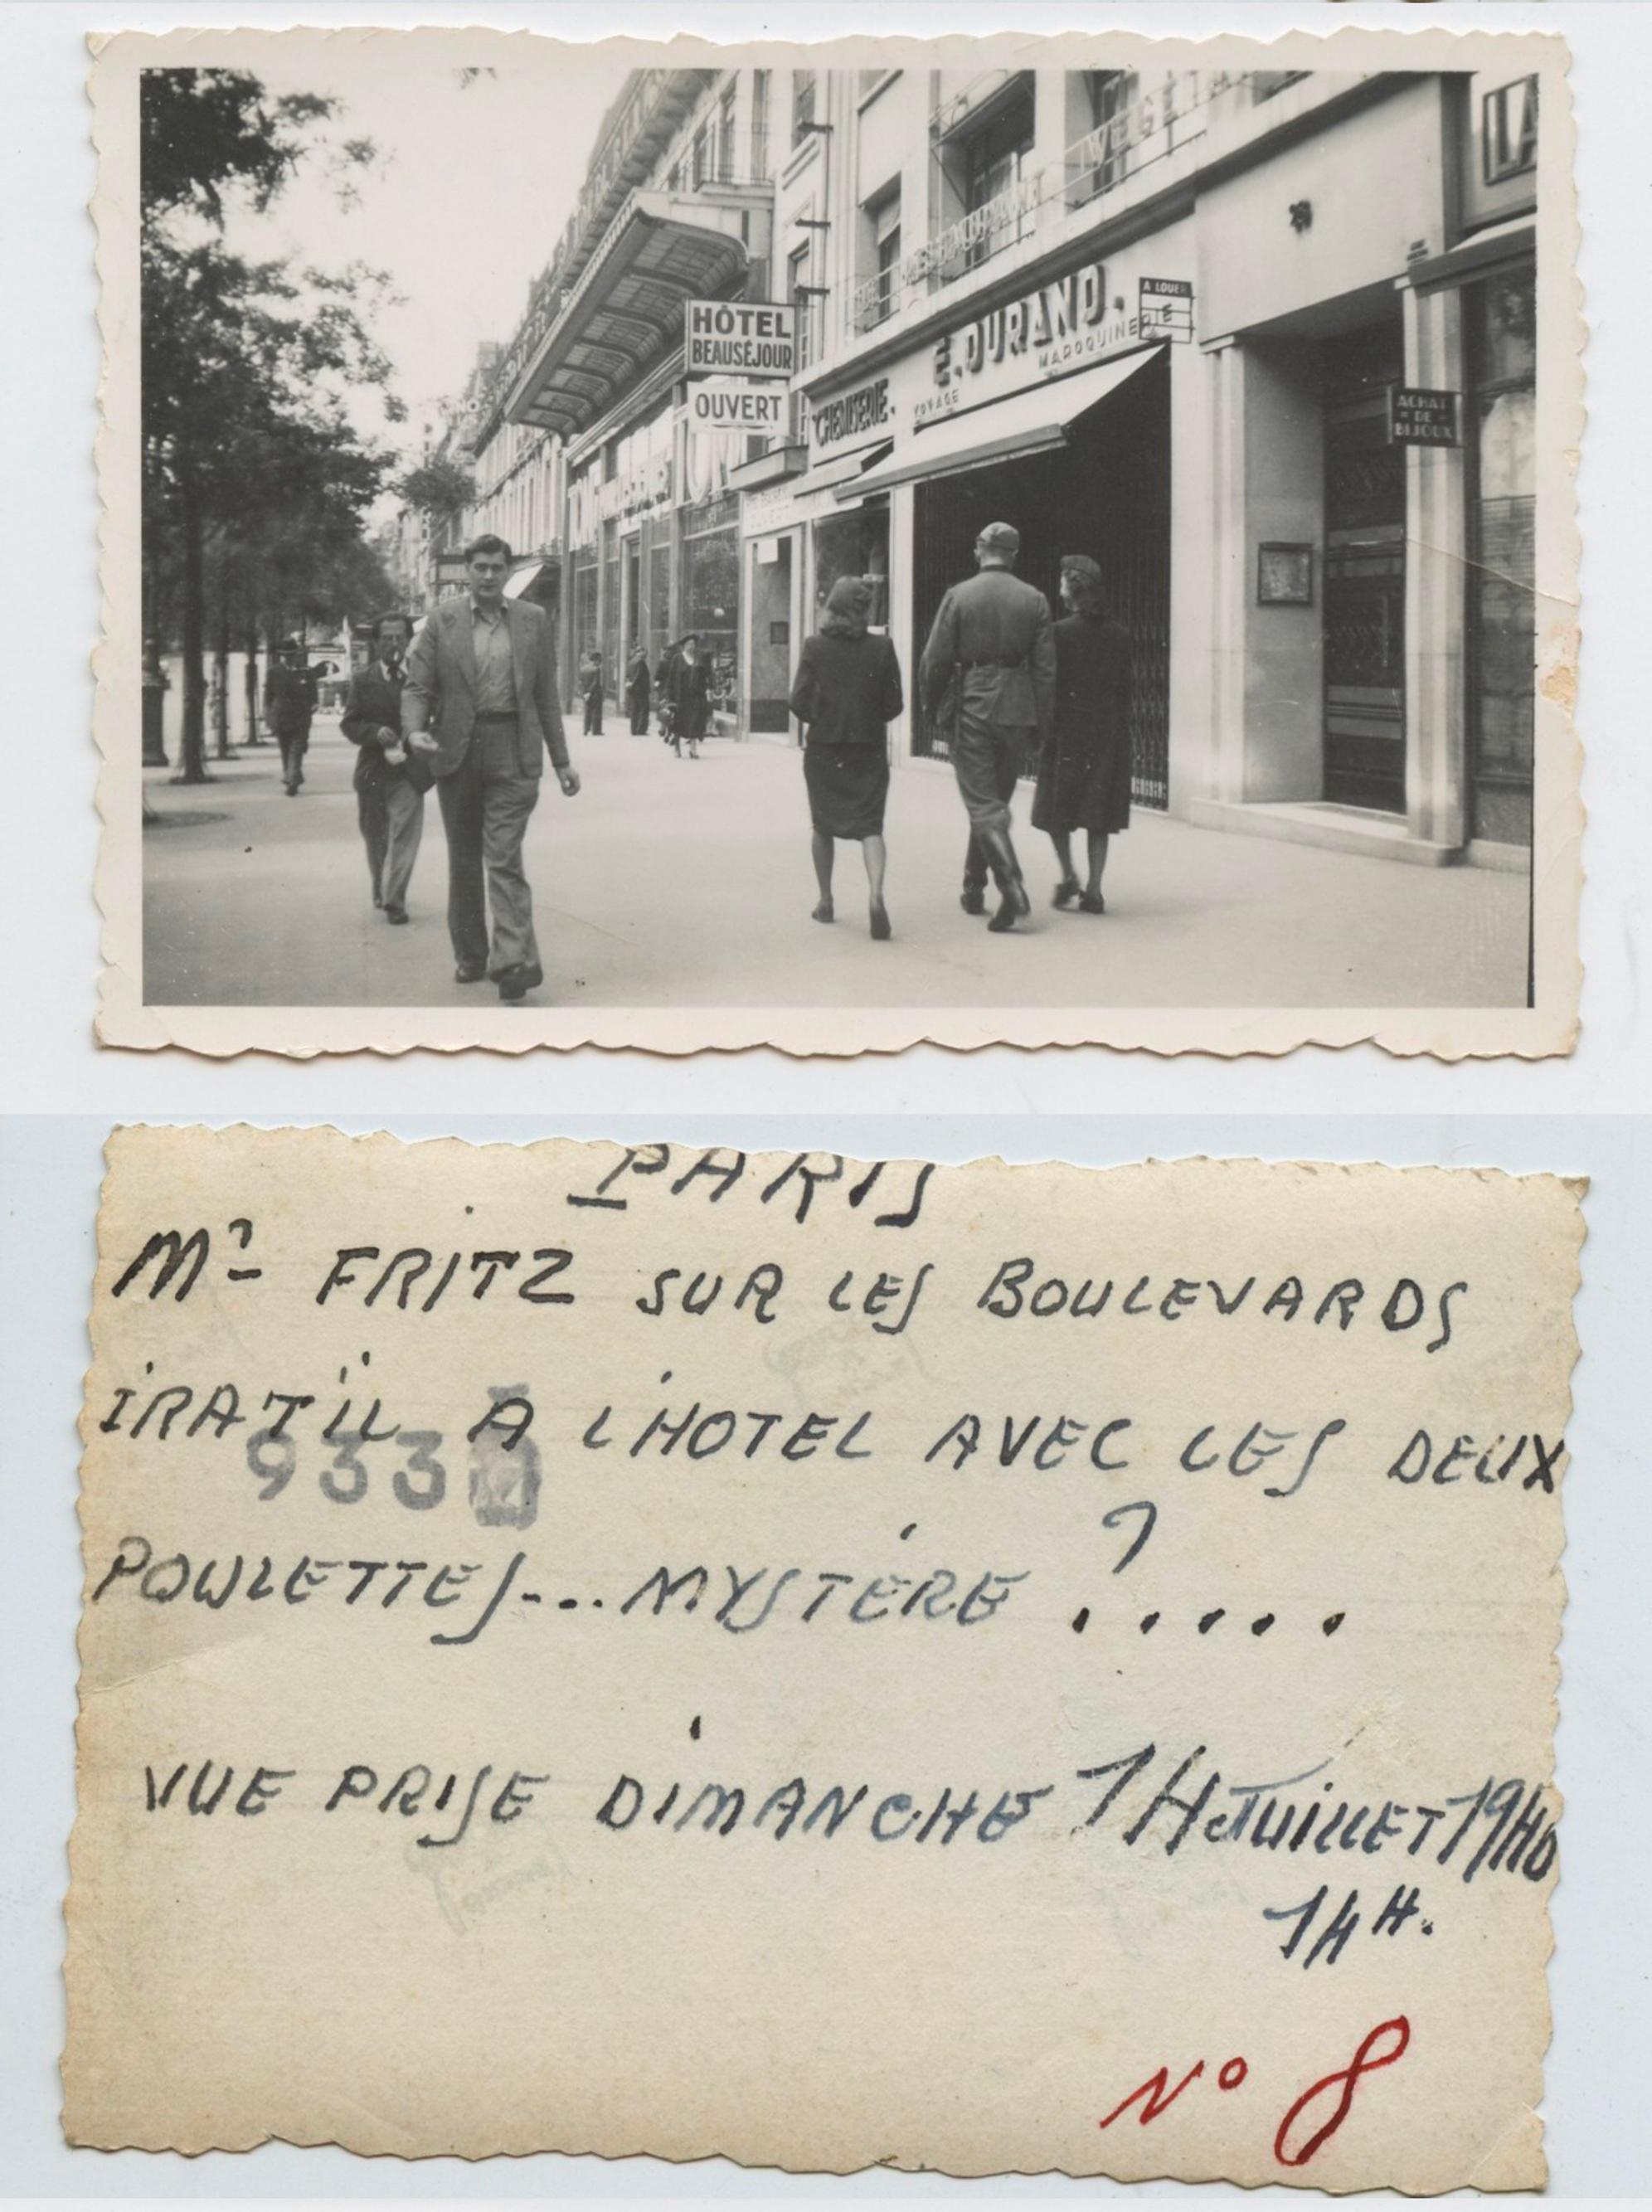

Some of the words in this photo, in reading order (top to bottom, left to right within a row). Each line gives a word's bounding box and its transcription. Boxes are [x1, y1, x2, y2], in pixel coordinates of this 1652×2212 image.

[693, 304, 791, 339] HÔTEL
[692, 338, 792, 370] BEAUSÉJOUR
[695, 392, 782, 421] OUVERT
[914, 389, 959, 416] VOYAGE
[1397, 394, 1446, 410] ACHAT
[1395, 421, 1454, 439] BIJOUX
[567, 1144, 935, 1228] PARIS
[316, 1205, 576, 1312] FRITZ
[635, 1263, 783, 1325] SUR
[828, 1262, 935, 1335] LES
[924, 1413, 1132, 1471] AVEC
[1178, 1417, 1347, 1499] LES
[1387, 1429, 1566, 1495] DEUX
[144, 1759, 295, 1816] VUE
[324, 1763, 549, 1850] PRISE
[595, 1715, 1055, 1845] DIMANCHE
[1445, 1775, 1558, 1884] 1940
[1273, 2015, 1411, 2168] 8
